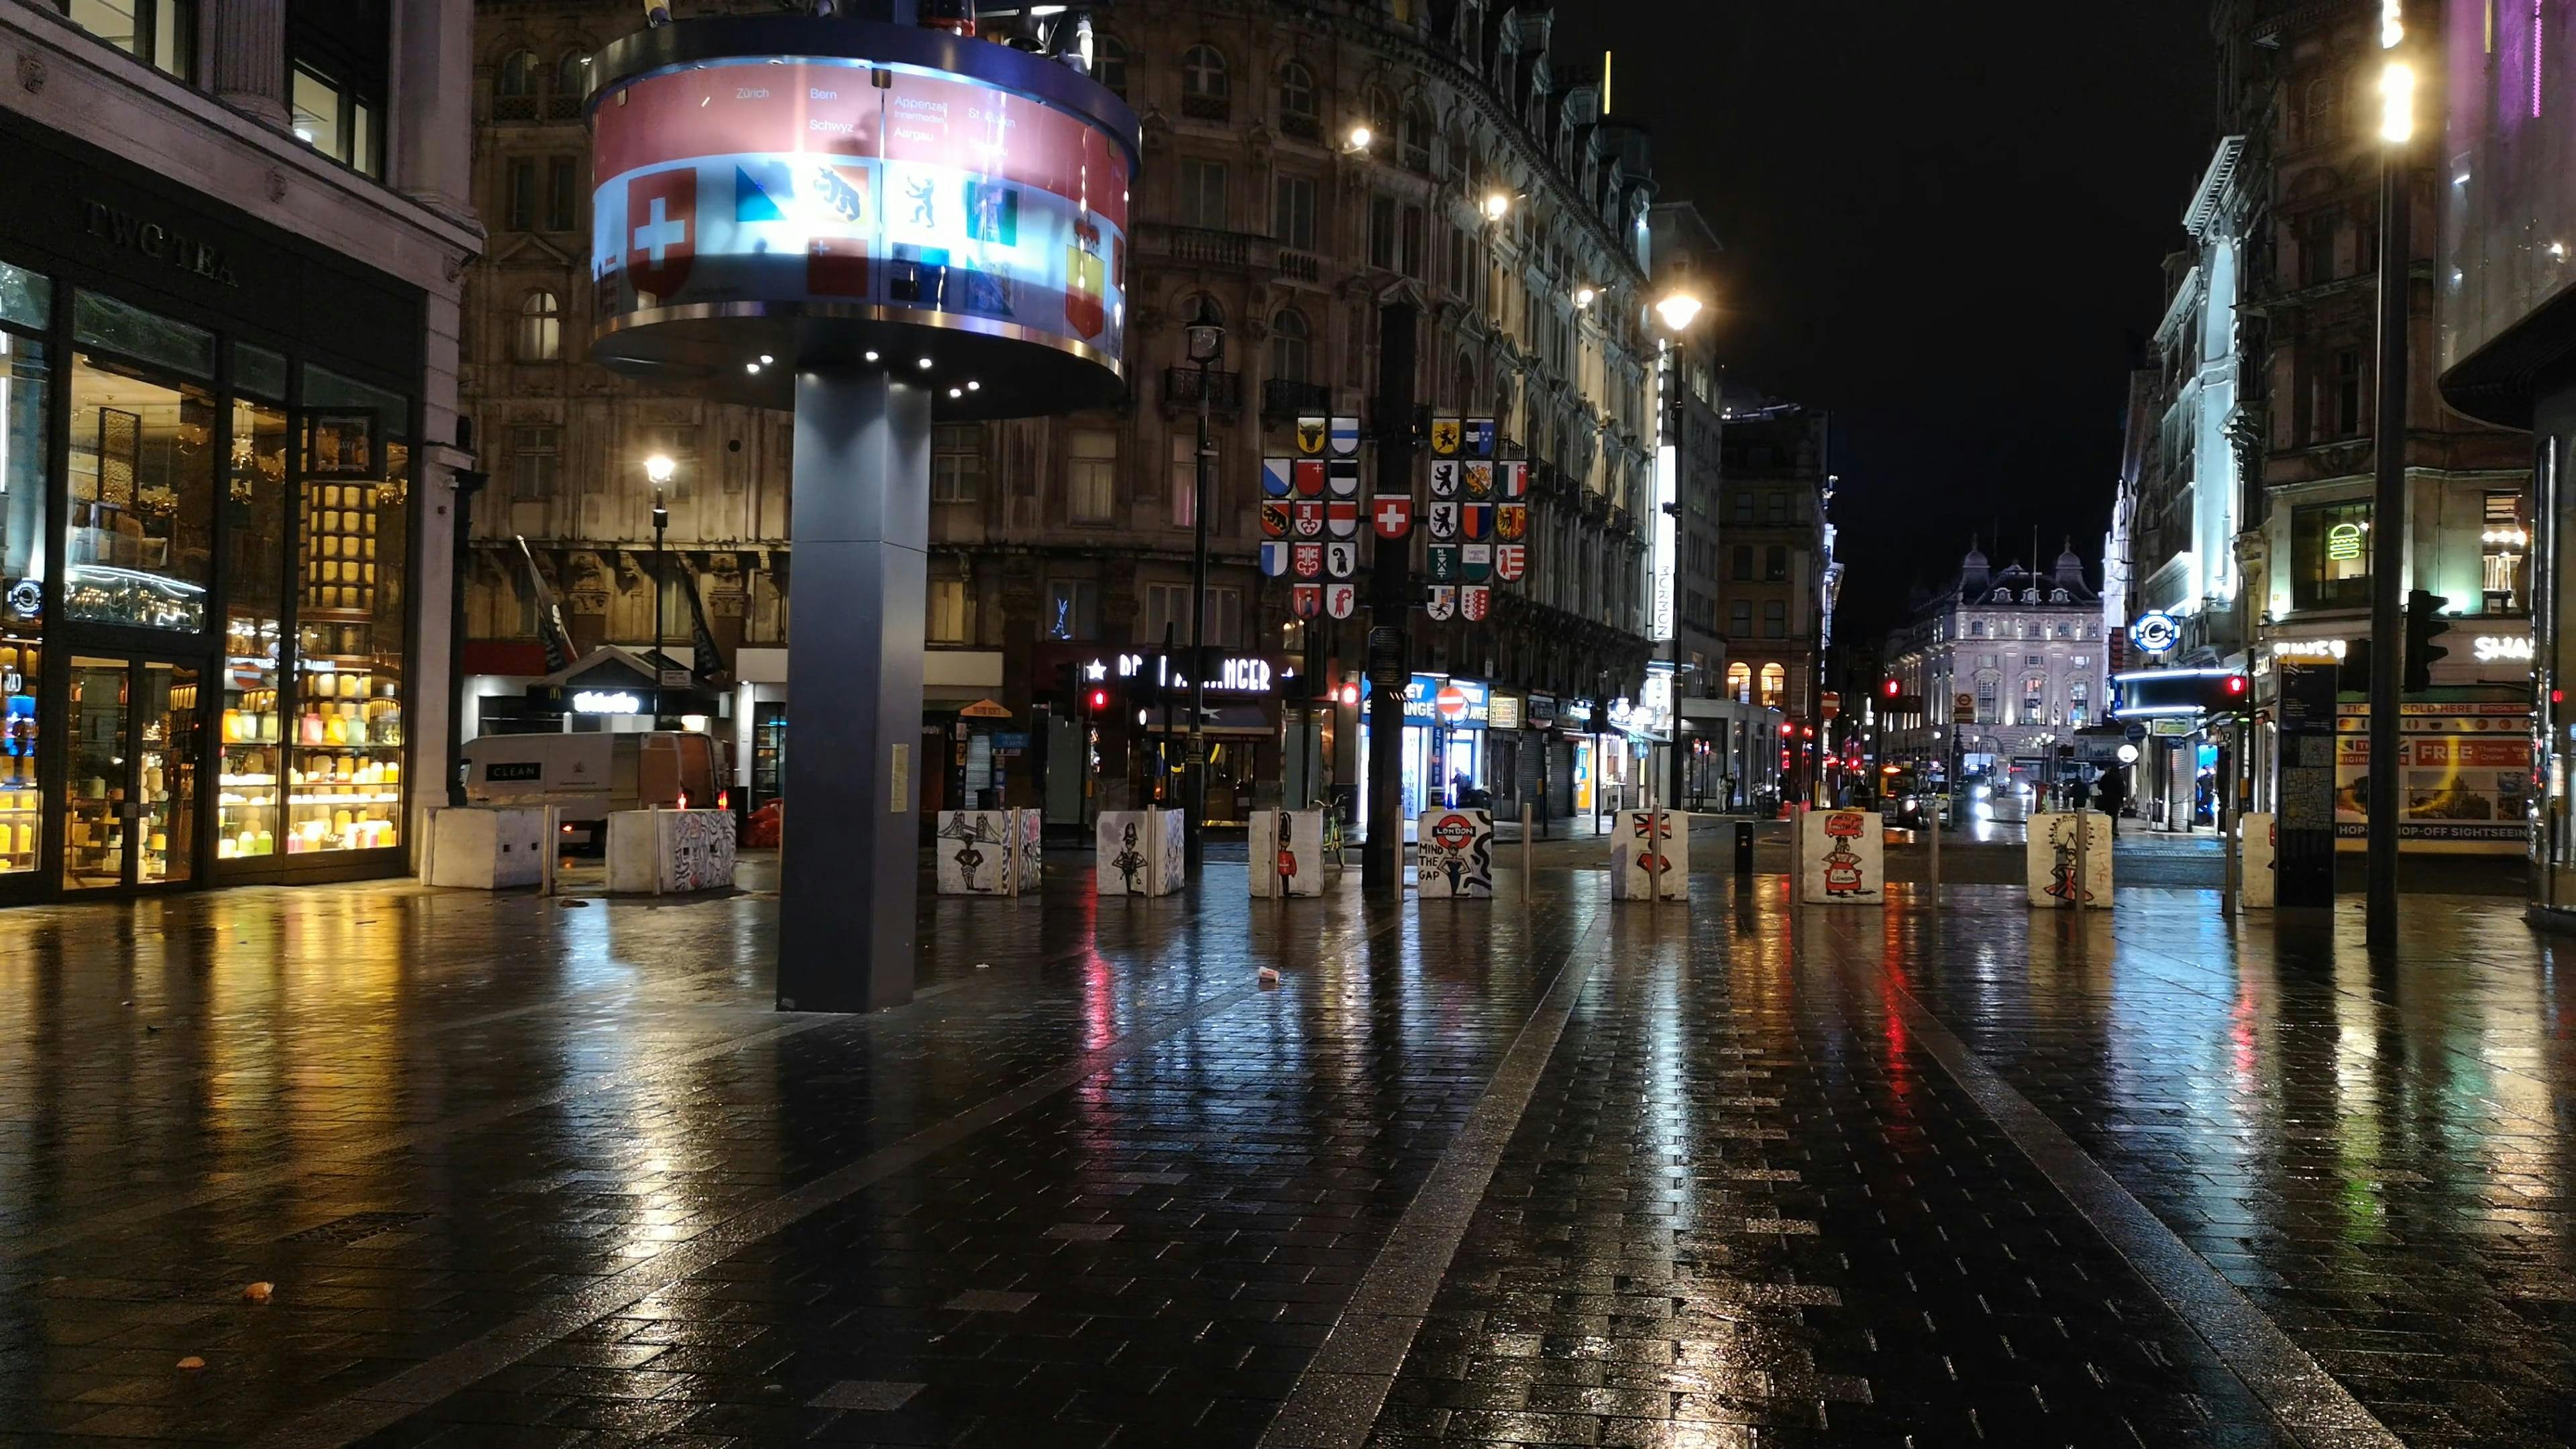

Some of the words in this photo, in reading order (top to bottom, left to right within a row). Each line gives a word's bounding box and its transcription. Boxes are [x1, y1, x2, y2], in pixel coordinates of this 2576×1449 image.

[736, 88, 769, 99] Zürich
[810, 88, 837, 99] Bern
[810, 119, 854, 133] Schwyz
[894, 126, 934, 142] Aargau
[1657, 566, 1670, 637] MORMON
[2402, 704, 2436, 714] SOLD
[2440, 704, 2472, 714] HERE
[2420, 745, 2473, 759] FREE
[493, 767, 535, 777] CLEAN
[2451, 827, 2529, 837] SIGHTSEEIN
[1419, 843, 1444, 855] MIND
[1419, 856, 1439, 867] THE
[1419, 869, 1440, 881] GAP
